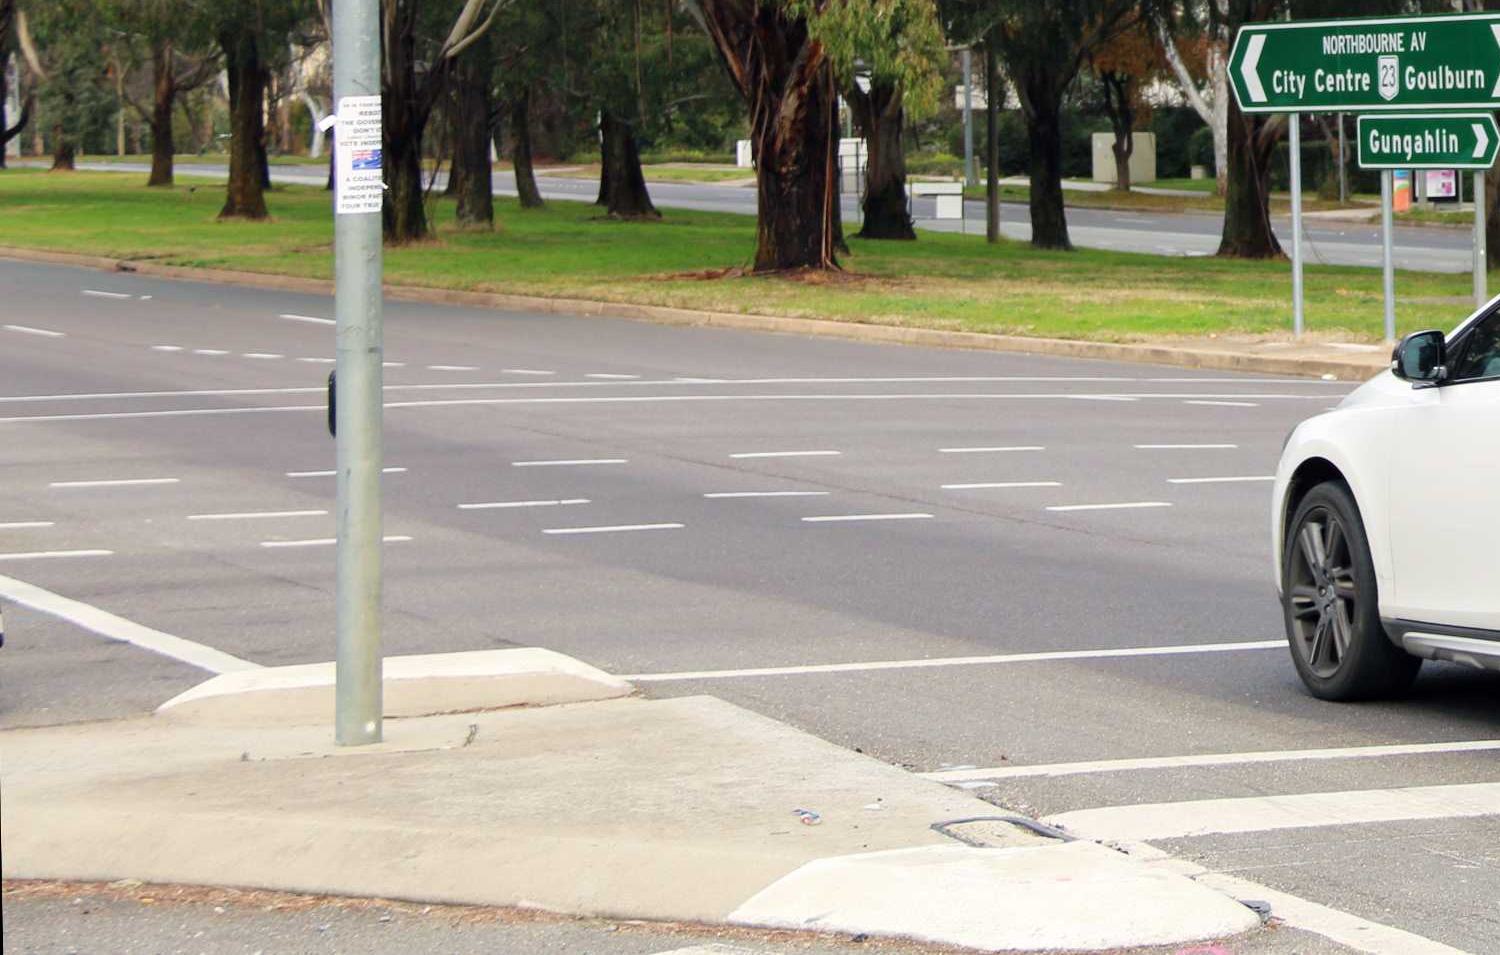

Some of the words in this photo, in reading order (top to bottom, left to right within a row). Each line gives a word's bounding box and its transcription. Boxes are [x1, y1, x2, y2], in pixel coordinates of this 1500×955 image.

[1322, 32, 1405, 55] NORTHBOURNE
[1410, 31, 1427, 52] AV
[1272, 70, 1306, 99] City
[1314, 68, 1371, 93] Centre
[1381, 64, 1396, 88] 23
[1405, 65, 1485, 91] Goulburn
[1369, 128, 1459, 162] Gungahlin
